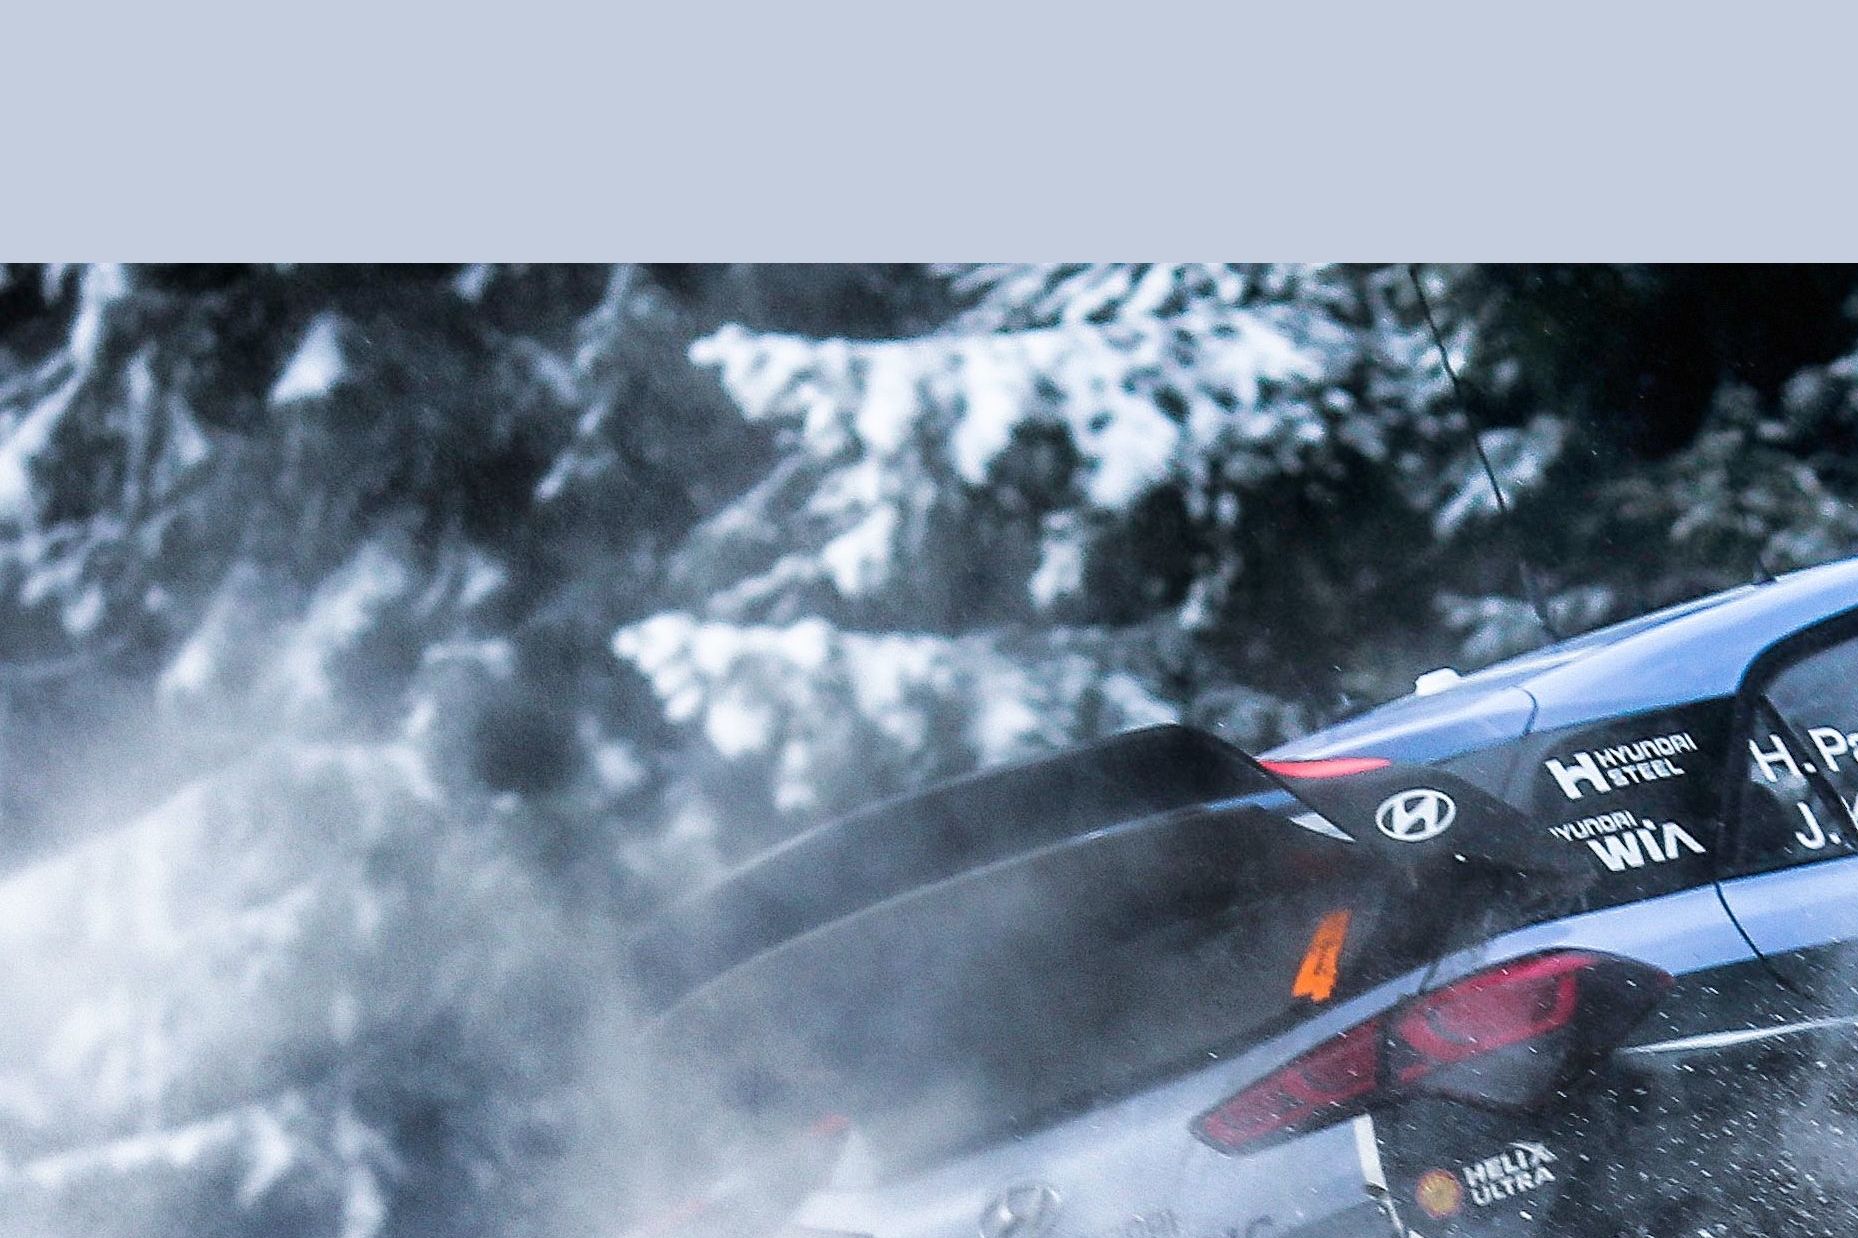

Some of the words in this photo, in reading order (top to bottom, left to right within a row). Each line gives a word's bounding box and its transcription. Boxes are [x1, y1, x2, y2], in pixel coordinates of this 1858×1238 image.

[1594, 732, 1699, 769] HYUNDAI
[1748, 734, 1816, 784] H.
[1607, 758, 1686, 787] STEEL
[1795, 801, 1843, 850] J.
[1470, 1166, 1557, 1207] ULTRA
